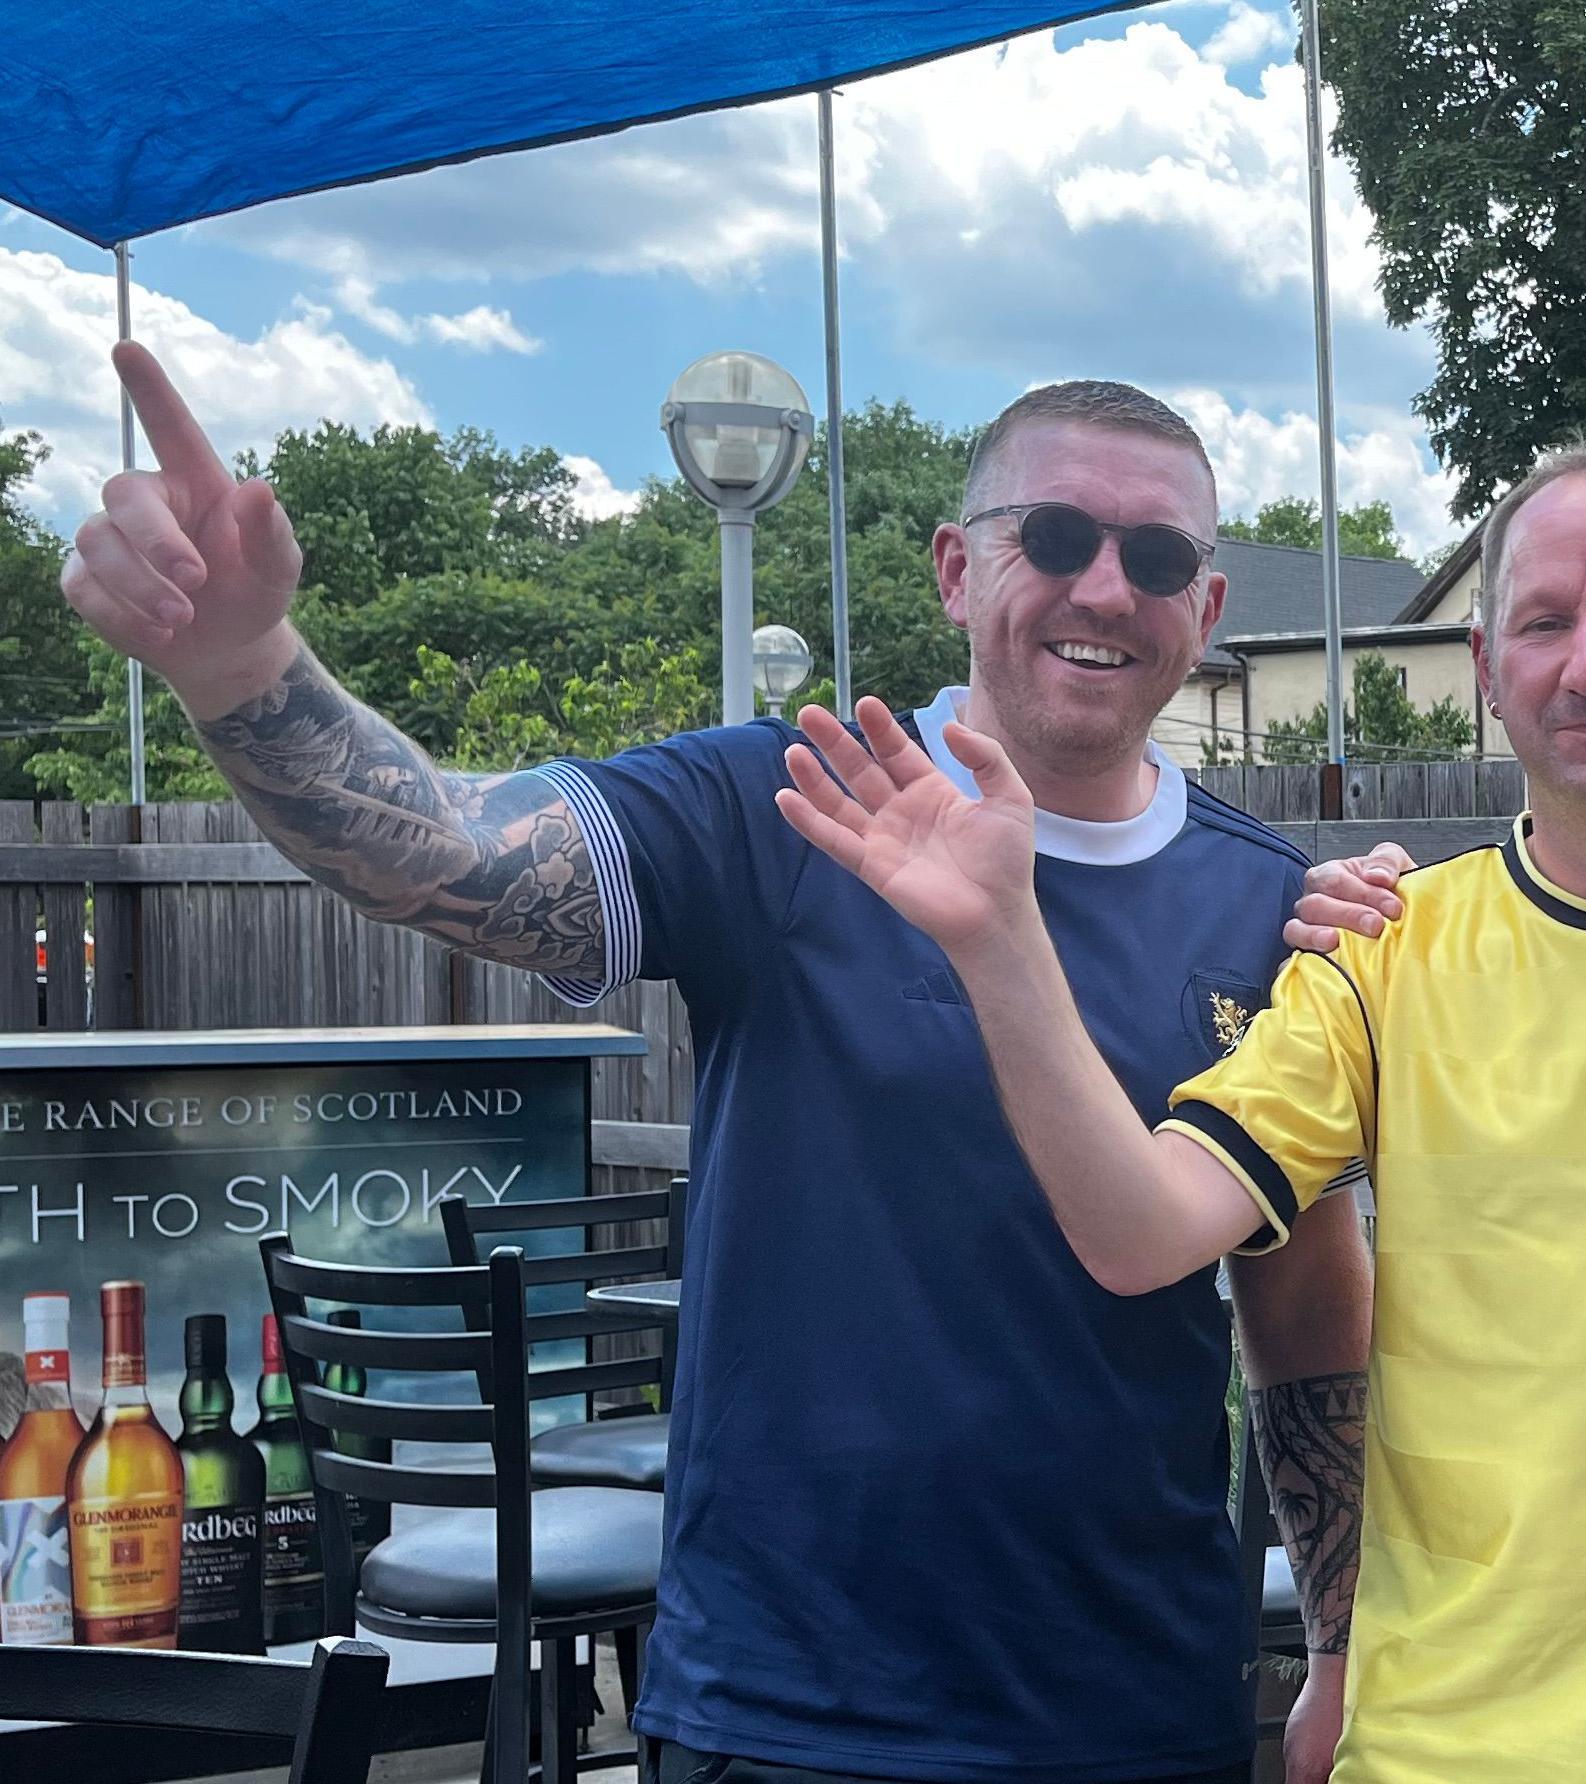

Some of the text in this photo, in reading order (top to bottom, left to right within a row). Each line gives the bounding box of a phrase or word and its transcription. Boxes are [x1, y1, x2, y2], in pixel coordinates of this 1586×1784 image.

[2, 1087, 523, 1132] E RANGE OF SCOTLAND
[112, 1192, 199, 1238] TO
[225, 1163, 523, 1233] SMOKY
[278, 1535, 289, 1551] 5
[196, 1575, 223, 1586] TEN
